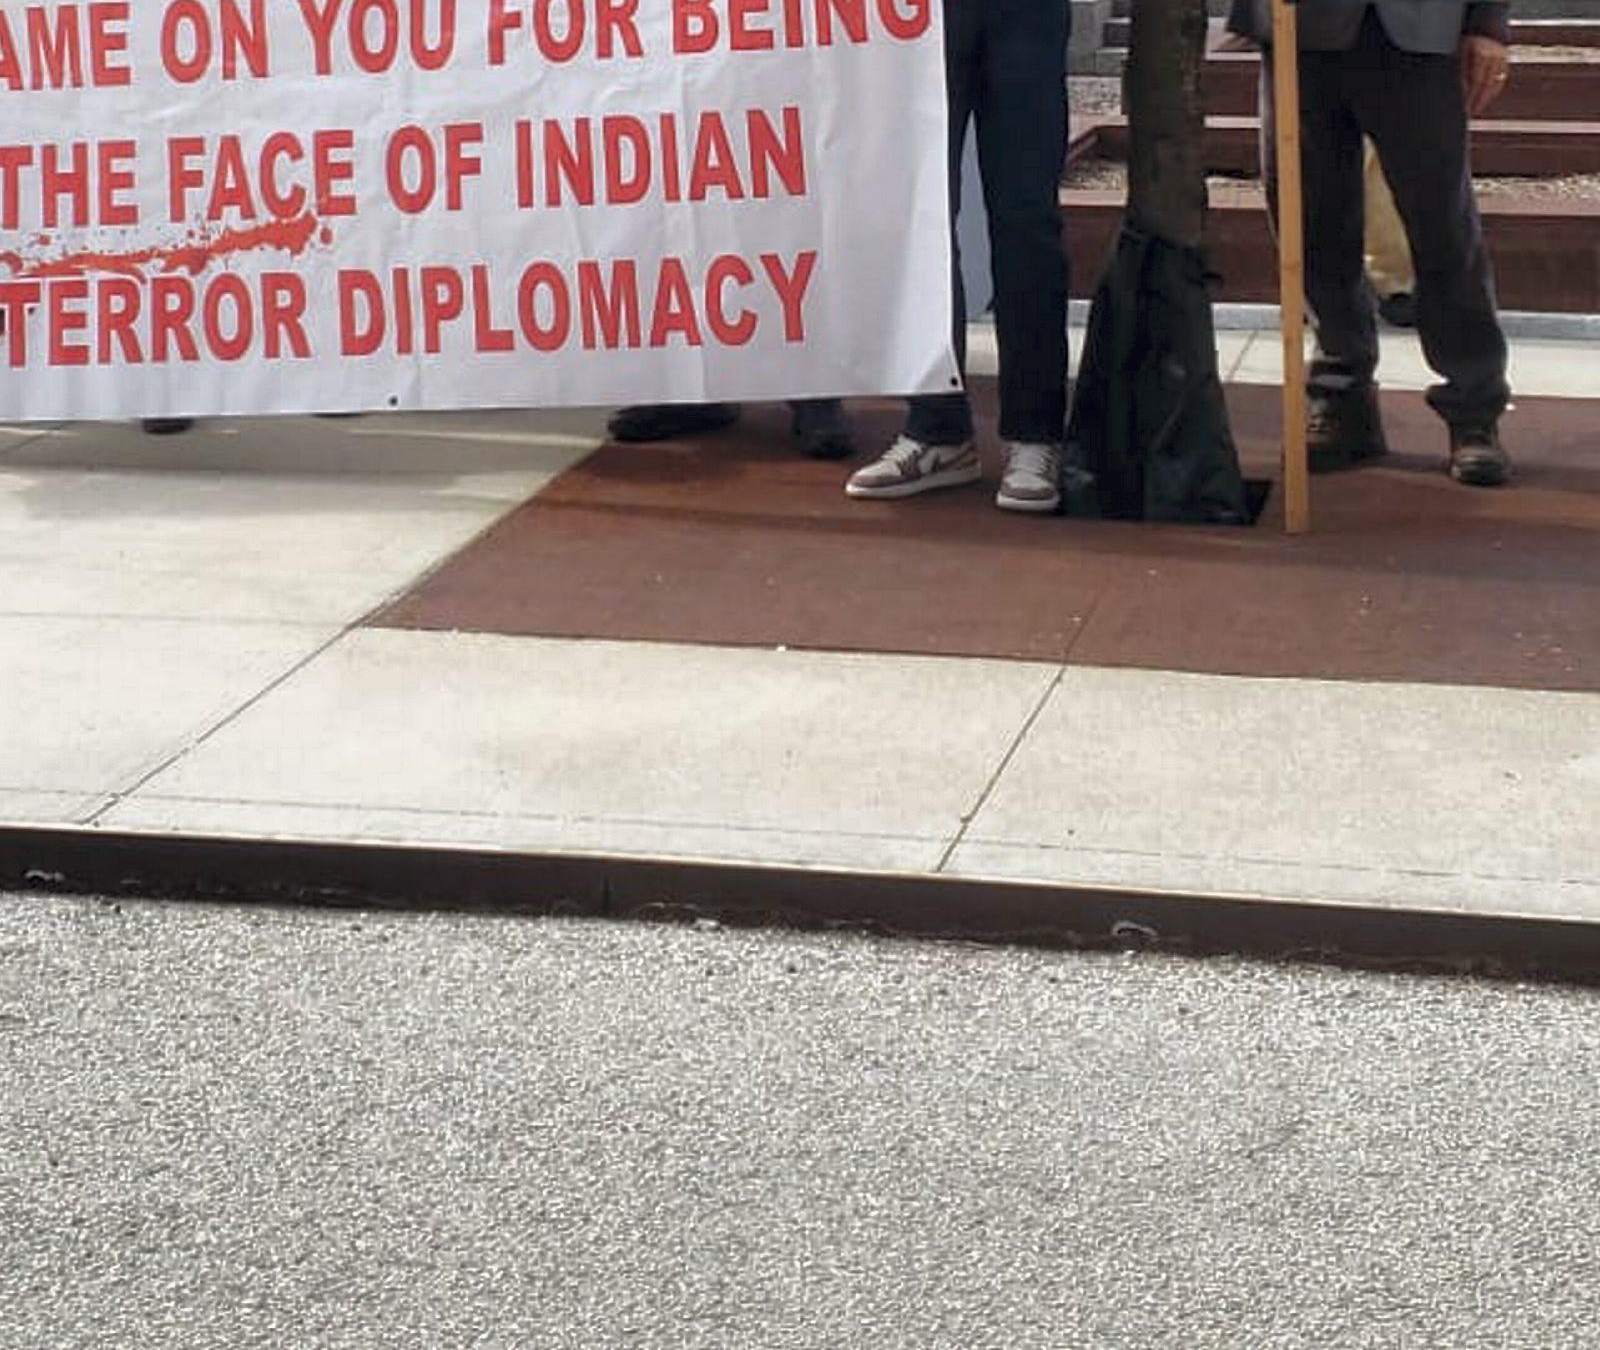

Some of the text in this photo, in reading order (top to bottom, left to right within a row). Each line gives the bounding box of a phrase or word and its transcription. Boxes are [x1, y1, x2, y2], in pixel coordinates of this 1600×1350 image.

[168, 129, 358, 224] FACE
[386, 121, 484, 215] OF
[515, 106, 807, 210] INDIAN
[338, 250, 818, 357] DIPLOMACY
